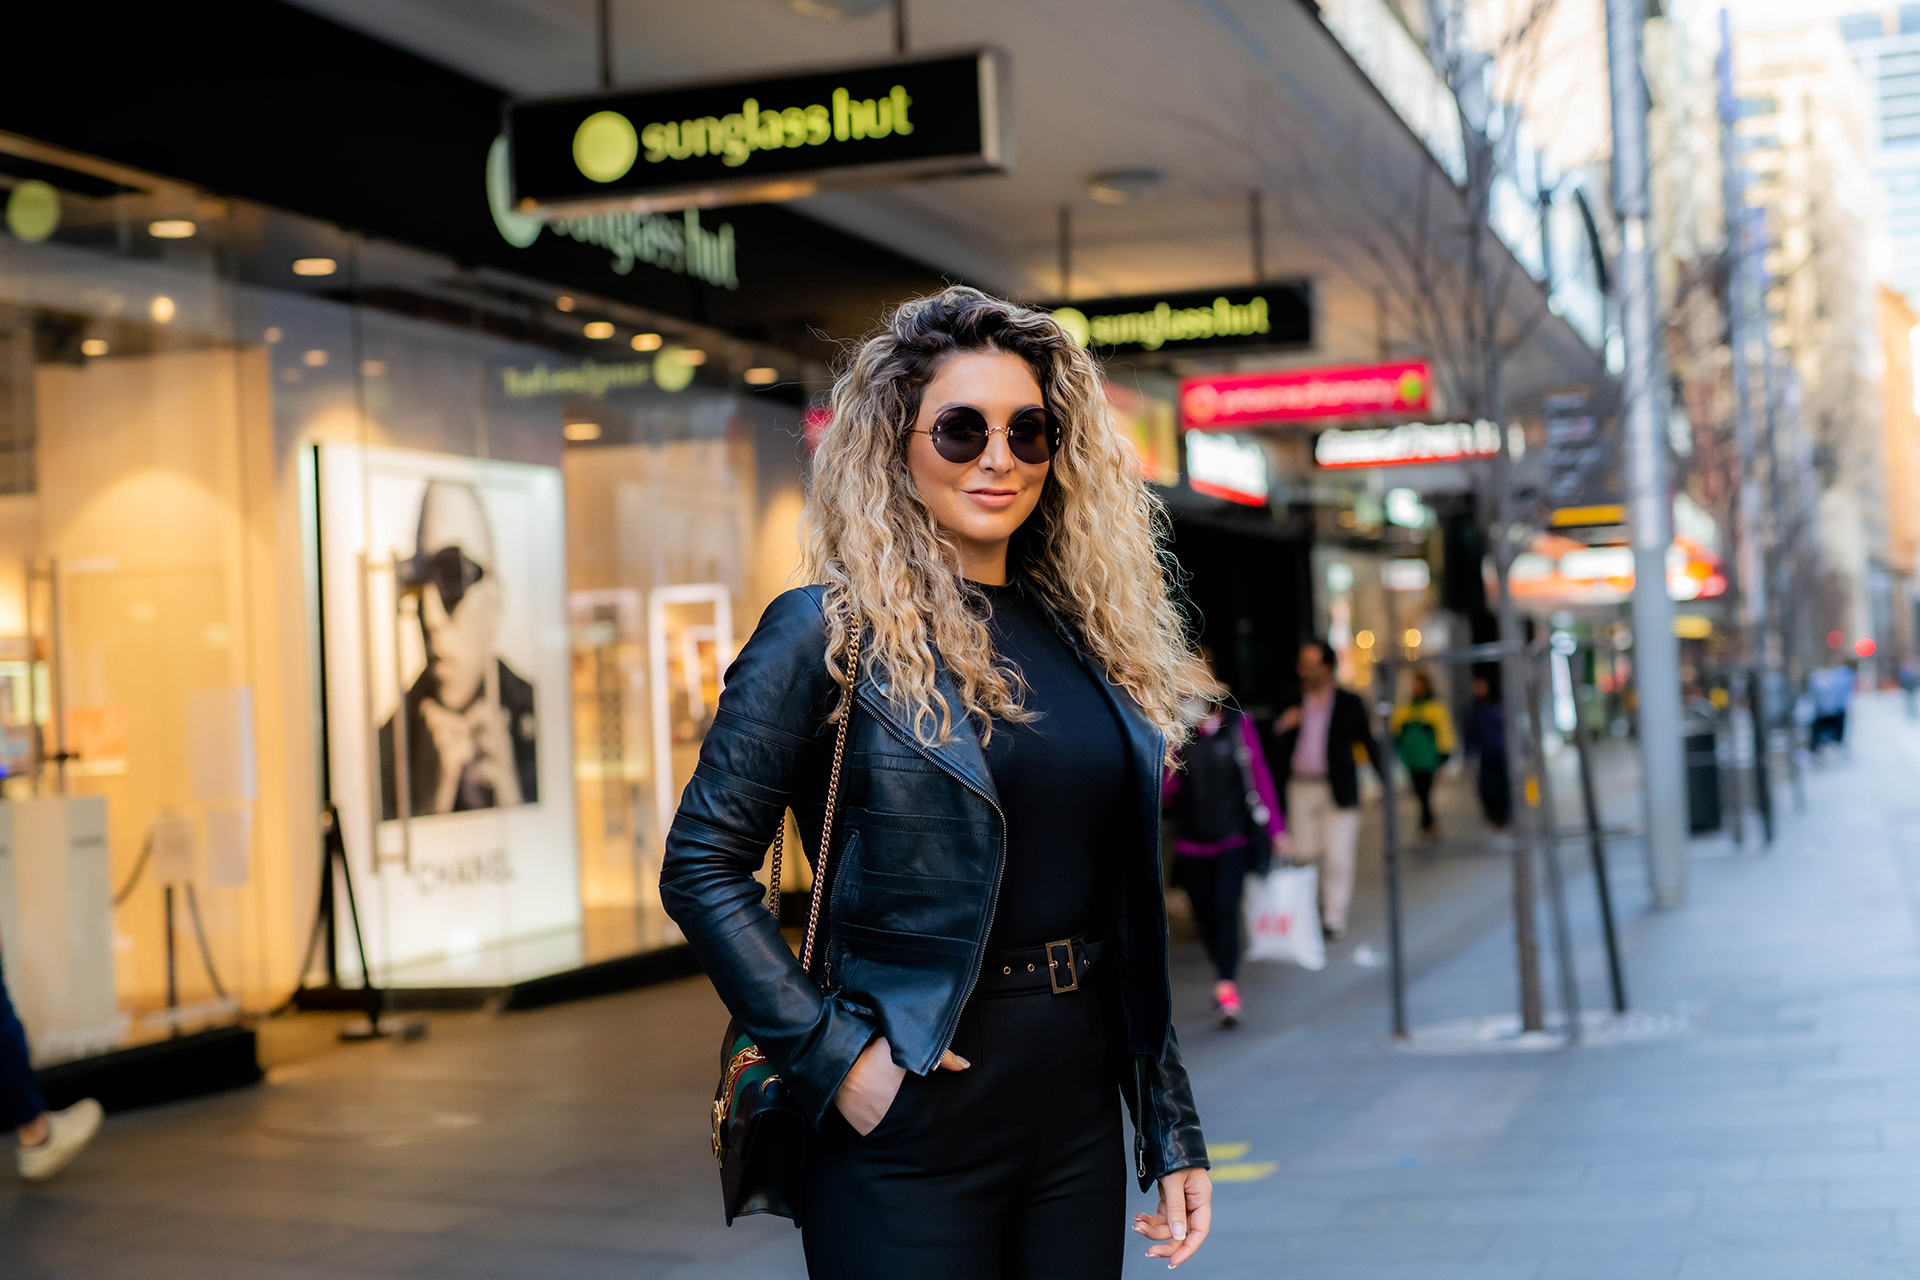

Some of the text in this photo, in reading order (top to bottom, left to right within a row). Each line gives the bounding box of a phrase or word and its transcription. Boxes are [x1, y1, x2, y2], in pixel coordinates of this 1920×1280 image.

[642, 85, 914, 167] sunglass hut
[684, 206, 740, 291] hut
[1089, 296, 1272, 351] sunglass hut
